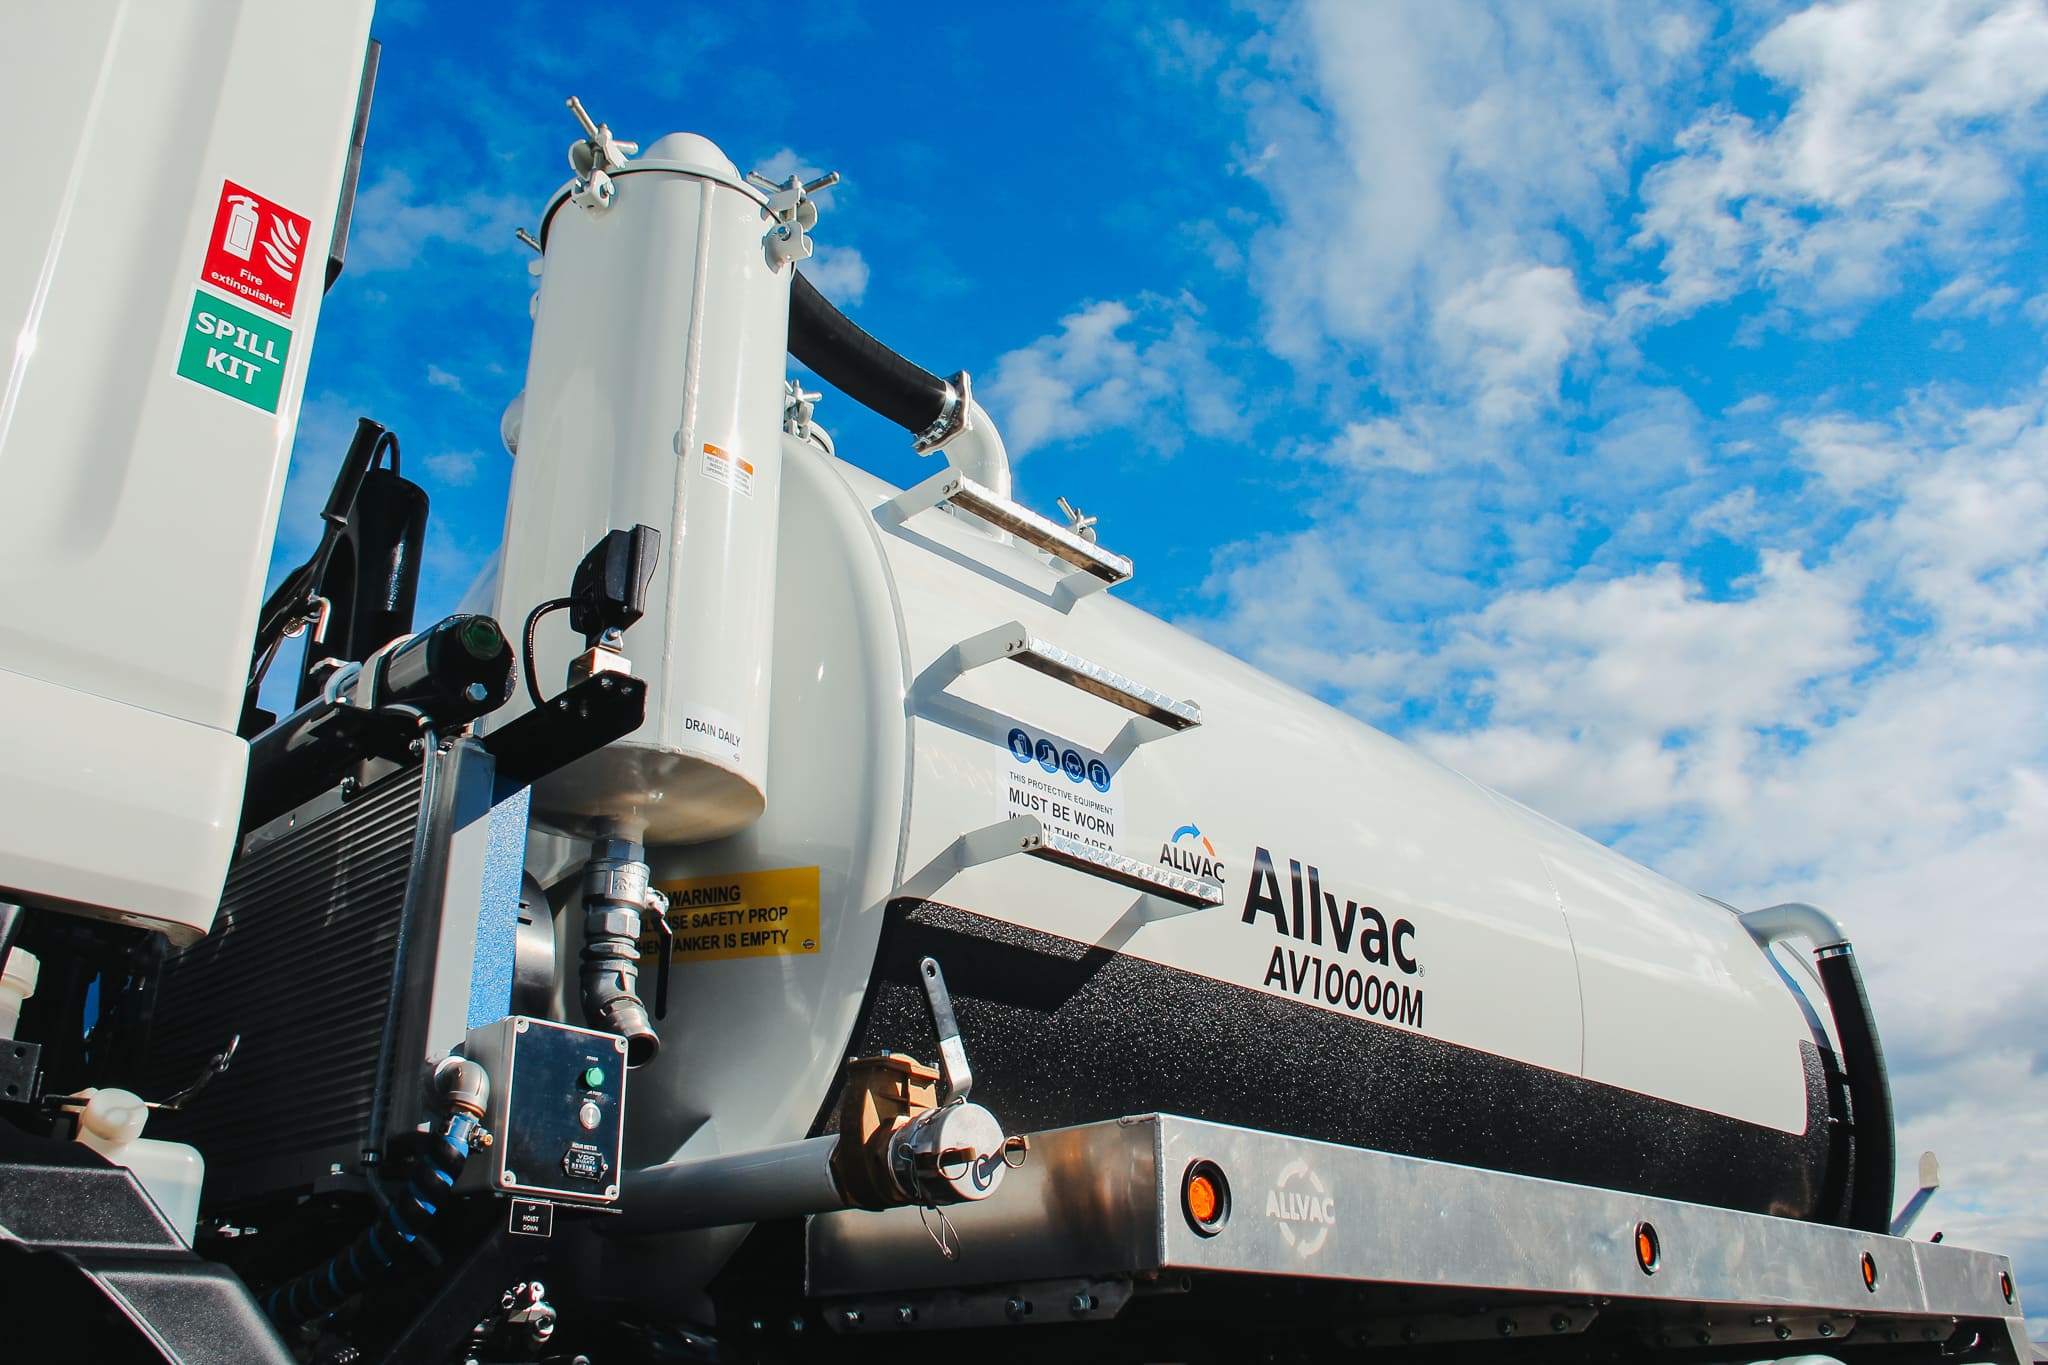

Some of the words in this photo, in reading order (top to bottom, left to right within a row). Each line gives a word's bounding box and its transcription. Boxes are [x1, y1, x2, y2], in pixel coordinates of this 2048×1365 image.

[210, 271, 286, 309] extinguisher
[239, 268, 263, 286] Fire
[195, 312, 280, 364] SPILL
[205, 347, 262, 385] KIT
[685, 718, 716, 737] DRAIN
[718, 728, 741, 747] DAILY
[1009, 771, 1026, 784] THIS
[1027, 778, 1073, 801] PROTECTIVE
[1073, 794, 1113, 815] EQUIPMENT
[1009, 787, 1048, 813] MUST
[1052, 802, 1070, 822] BE
[1074, 809, 1115, 837] WORN
[1159, 843, 1225, 883] ALLVAC
[667, 885, 741, 906] WARNING
[1241, 845, 1418, 975] Allvac
[691, 909, 745, 928] SAFETY
[748, 906, 788, 924] PROP
[676, 933, 720, 950] ANKER
[724, 933, 737, 948] IS
[740, 929, 789, 948] EMPTY
[1263, 945, 1424, 1029] AV10000M
[522, 1214, 540, 1223] HOIST
[1265, 1189, 1337, 1225] ALLVAC
[522, 1224, 539, 1232] DOWN
